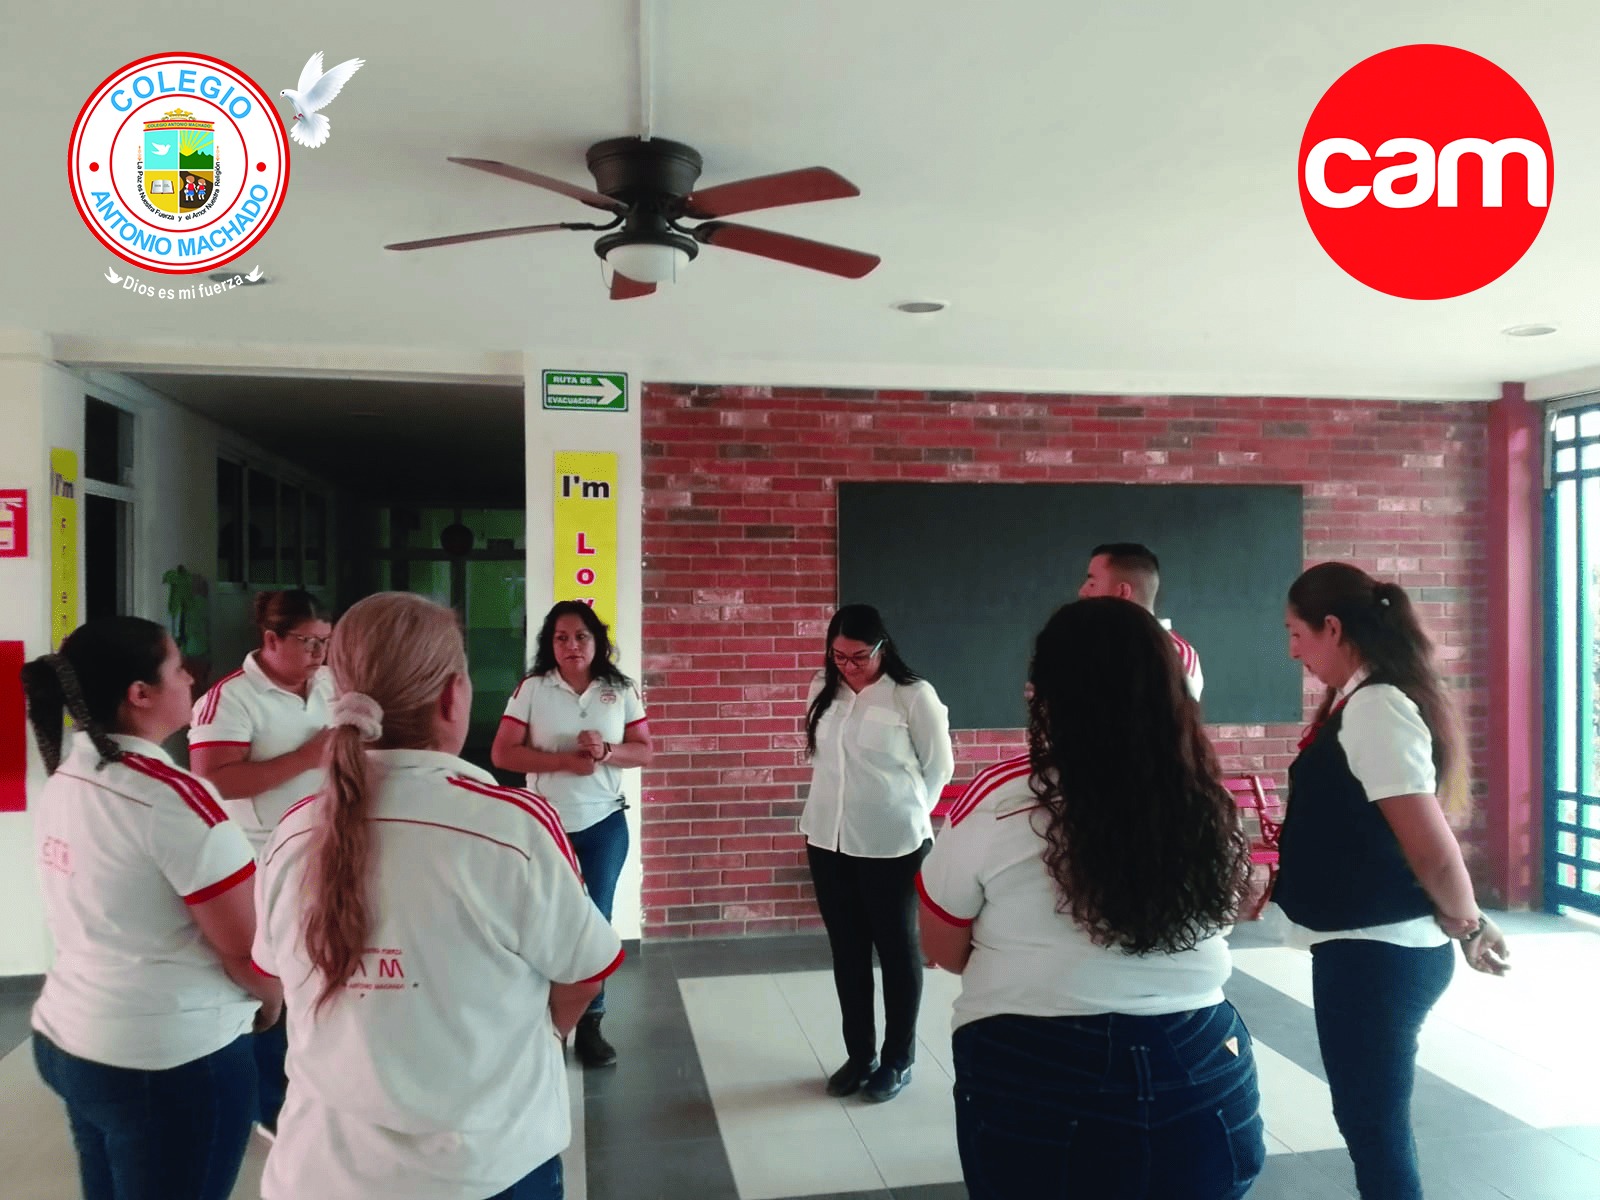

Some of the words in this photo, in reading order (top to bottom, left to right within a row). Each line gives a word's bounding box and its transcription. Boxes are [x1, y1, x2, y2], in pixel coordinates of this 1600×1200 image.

[553, 376, 578, 384] RUTA
[579, 376, 592, 384] DE
[562, 475, 610, 498] I'm
